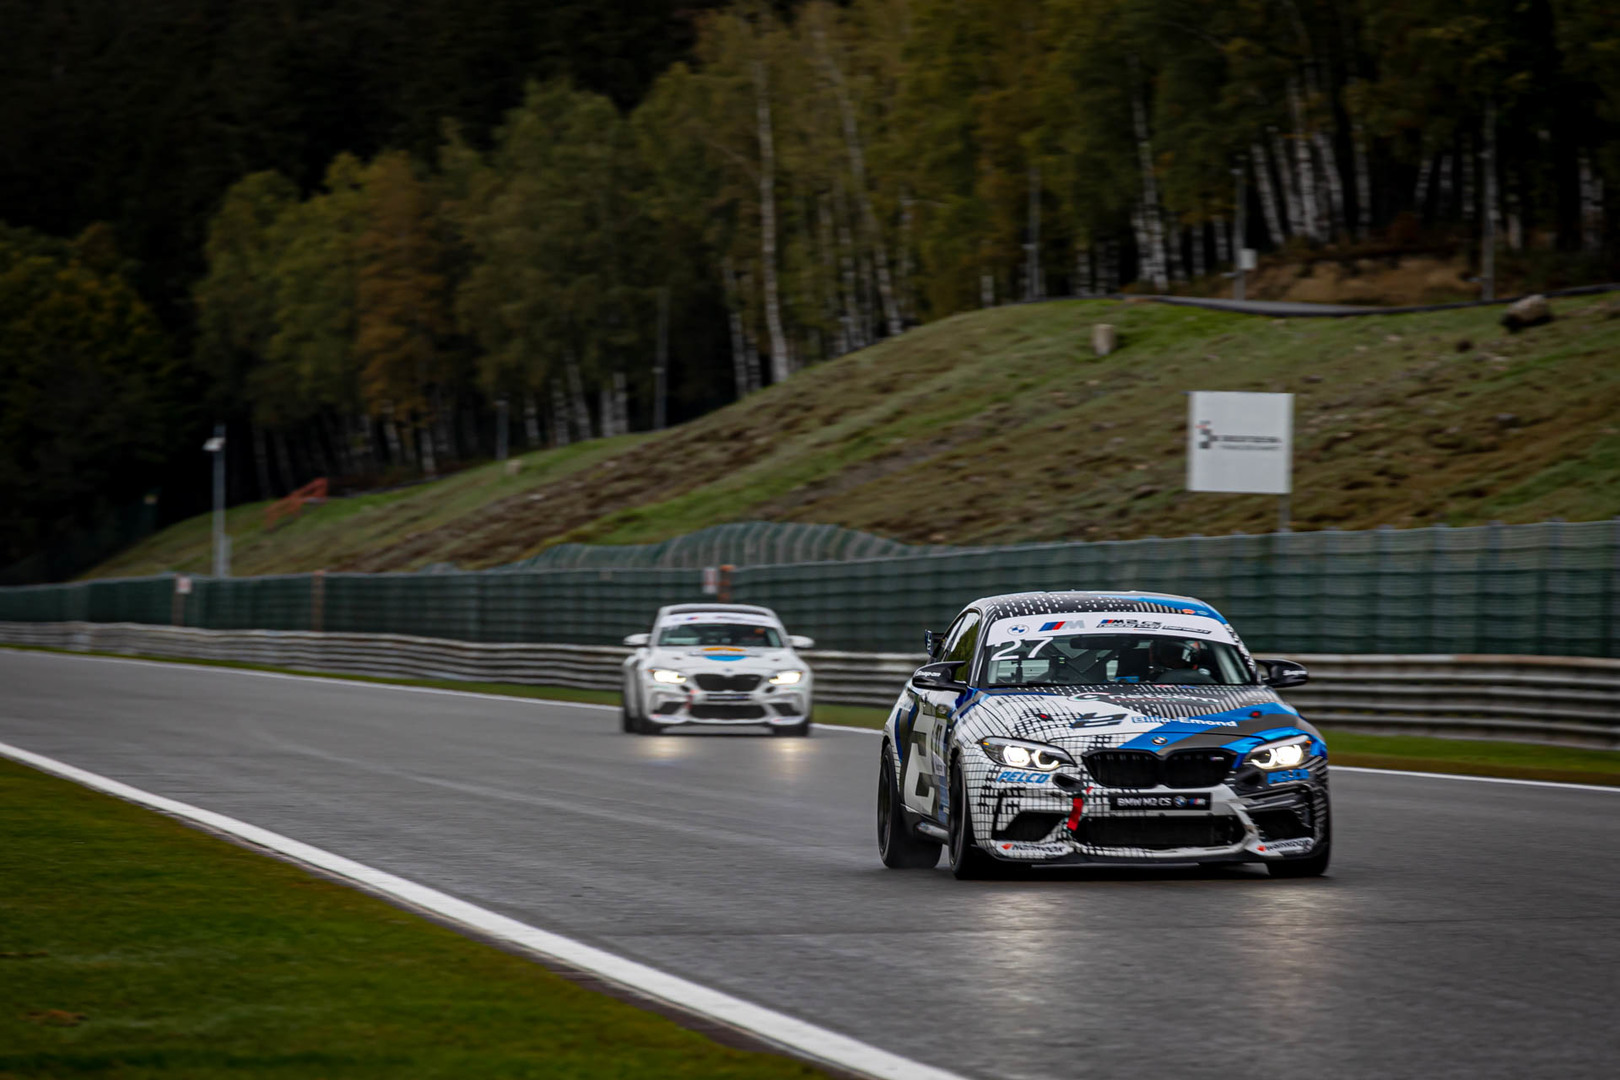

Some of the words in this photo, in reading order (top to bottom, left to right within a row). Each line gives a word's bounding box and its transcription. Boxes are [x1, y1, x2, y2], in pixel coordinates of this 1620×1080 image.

[991, 637, 1053, 661] 27
[996, 771, 1051, 784] PELCO
[1117, 797, 1142, 806] BMW
[1143, 797, 1158, 806] M2
[1159, 797, 1172, 806] CS
